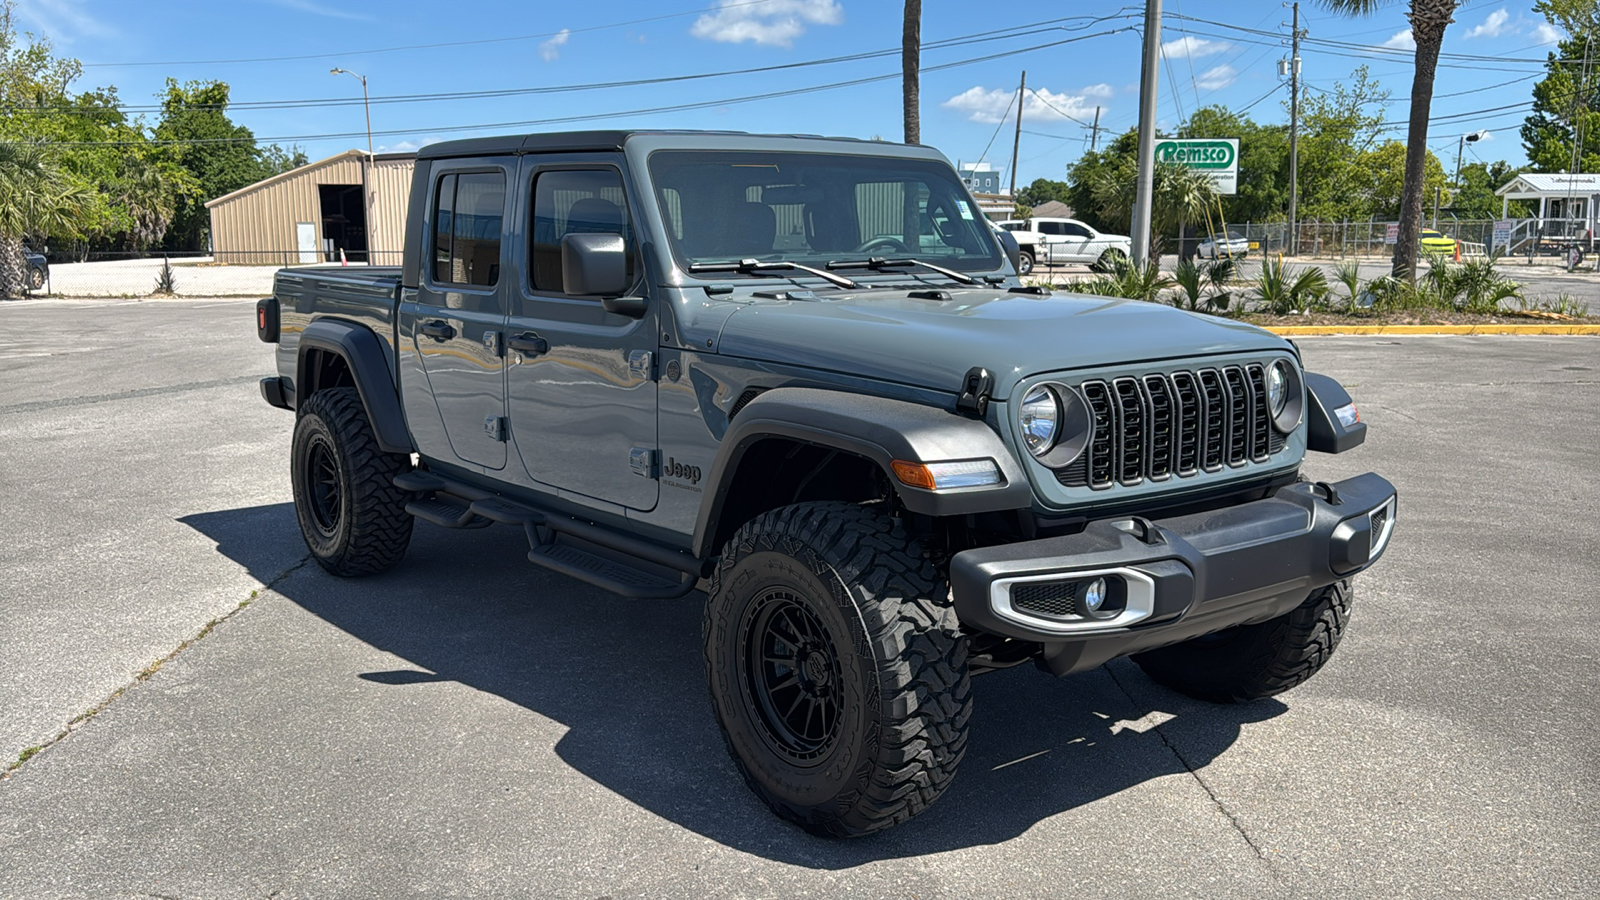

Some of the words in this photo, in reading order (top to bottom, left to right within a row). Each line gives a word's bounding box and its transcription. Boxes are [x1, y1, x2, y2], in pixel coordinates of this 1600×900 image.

[1162, 142, 1227, 162] Remsco
[664, 457, 701, 484] Jeep
[668, 480, 702, 493] GLADIATOR
